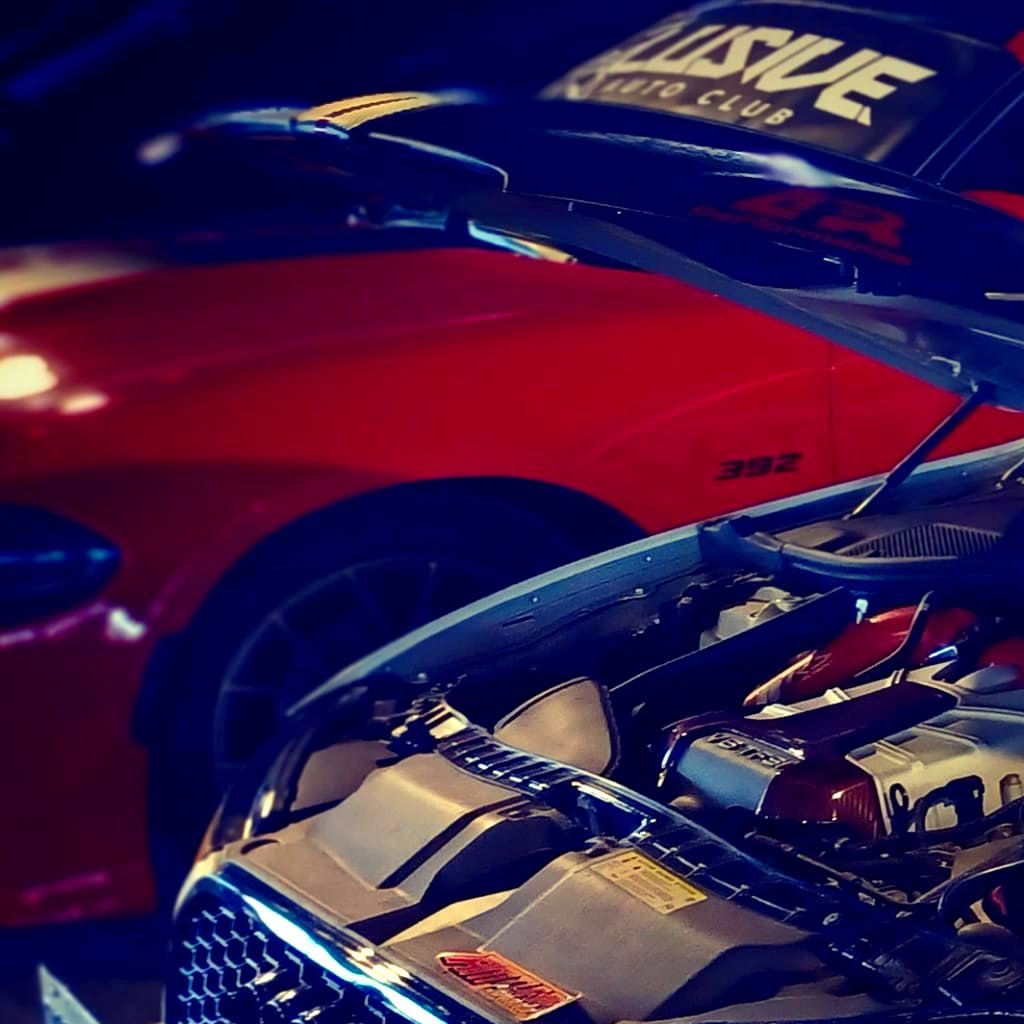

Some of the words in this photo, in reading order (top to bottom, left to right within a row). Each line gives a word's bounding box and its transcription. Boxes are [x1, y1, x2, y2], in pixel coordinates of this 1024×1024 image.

[602, 78, 686, 98] AUTO
[697, 90, 794, 126] CLUB
[714, 452, 802, 481] 392
